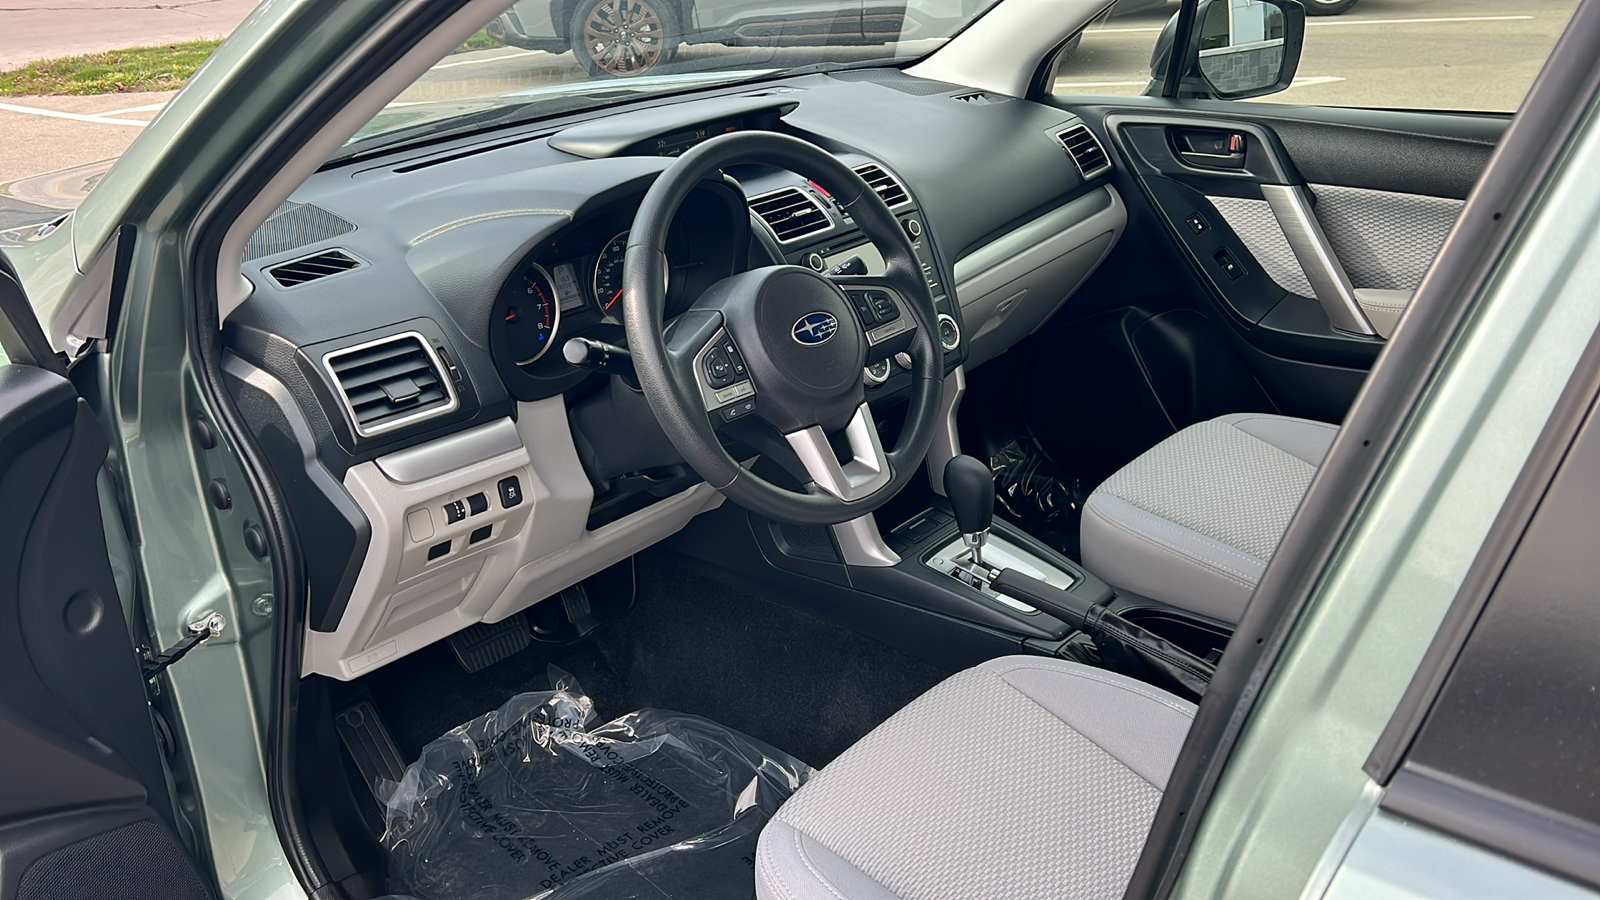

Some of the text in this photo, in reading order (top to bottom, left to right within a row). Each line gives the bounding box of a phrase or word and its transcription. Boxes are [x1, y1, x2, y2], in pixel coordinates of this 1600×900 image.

[558, 266, 563, 275] P
[537, 322, 544, 330] 8
[600, 763, 630, 783] MUST
[630, 782, 668, 814] DEALER
[493, 813, 522, 835] MUST
[540, 800, 690, 890] DEALER MUST REMOVE
[631, 825, 675, 850] COVER
